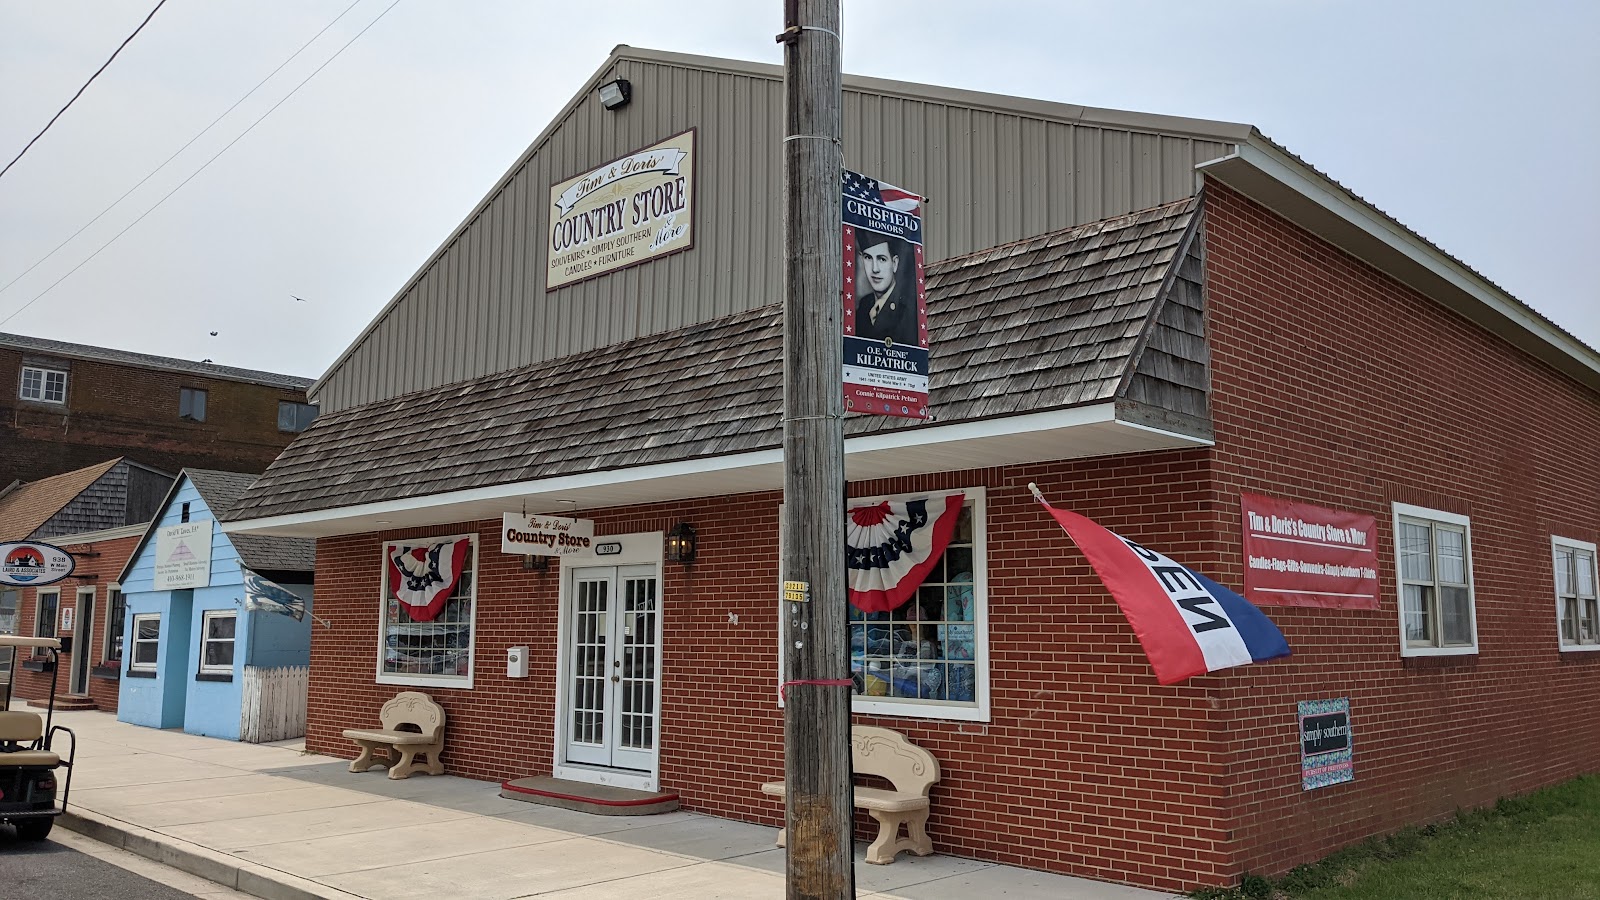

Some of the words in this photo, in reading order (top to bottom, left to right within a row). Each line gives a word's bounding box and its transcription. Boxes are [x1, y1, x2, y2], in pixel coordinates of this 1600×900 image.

[576, 176, 605, 198] Tim
[608, 166, 617, 180] &
[552, 198, 626, 252] COUNTRY
[632, 176, 686, 226] STORE
[664, 216, 674, 228] &
[847, 200, 918, 232] CRISFIELD
[650, 223, 686, 250] More
[868, 220, 904, 234] HONORS
[551, 250, 586, 268] SOUVENIRS
[591, 240, 616, 256] SIMPLY
[616, 227, 652, 248] SOUTHERN
[564, 260, 592, 276] CANDLES
[598, 247, 635, 266] FURNITURE
[856, 353, 918, 372] KILPATRICK
[866, 346, 882, 356] O.E.
[883, 348, 909, 359] "GENE"
[856, 390, 874, 398] Connie
[876, 392, 901, 400] Kilpatrick
[528, 518, 542, 528] Tim
[544, 520, 552, 530] &
[1248, 511, 1264, 532] Tim
[1264, 516, 1272, 532] &
[1272, 514, 1298, 536] Doris's
[1298, 518, 1326, 542] Country
[1326, 524, 1346, 543] Store
[1345, 529, 1352, 544] &
[506, 528, 556, 548] Country
[558, 532, 590, 548] Store
[560, 546, 580, 555] More
[1304, 722, 1323, 747] simply
[1323, 720, 1347, 738] southern
[1305, 768, 1322, 776] PURSUIT
